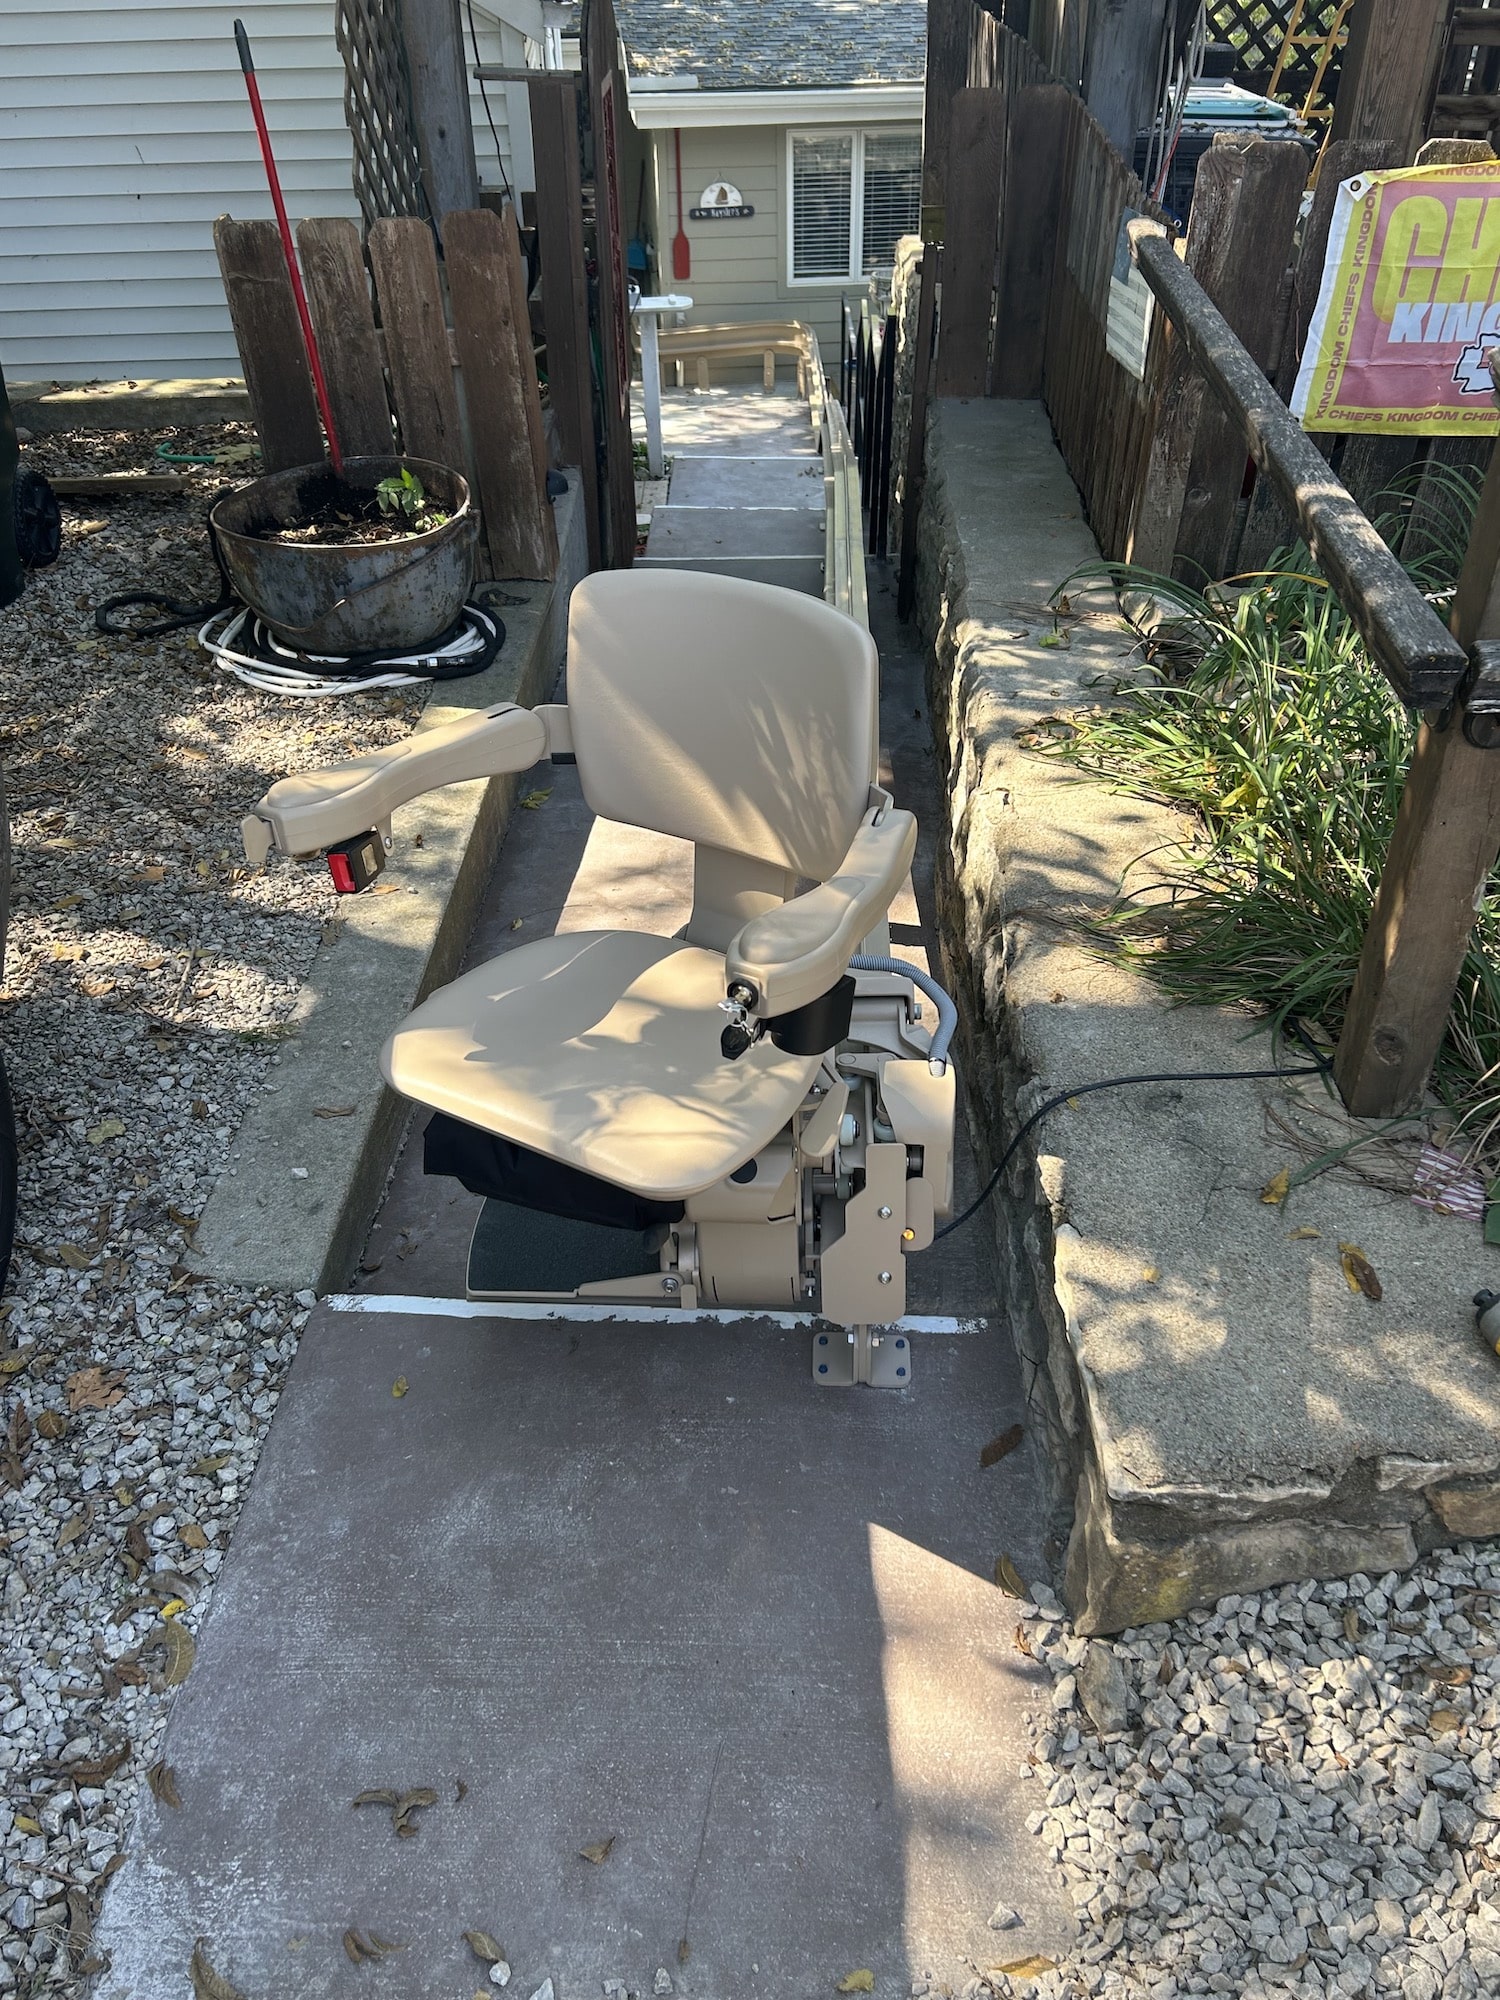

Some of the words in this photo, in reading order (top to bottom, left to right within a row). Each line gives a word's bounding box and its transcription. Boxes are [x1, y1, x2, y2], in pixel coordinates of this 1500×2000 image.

[1315, 341, 1345, 419] KINGDOM
[1338, 272, 1360, 337] CHIEFS
[1328, 409, 1383, 422] CHIEFS
[1387, 411, 1459, 422] KINGDOM
